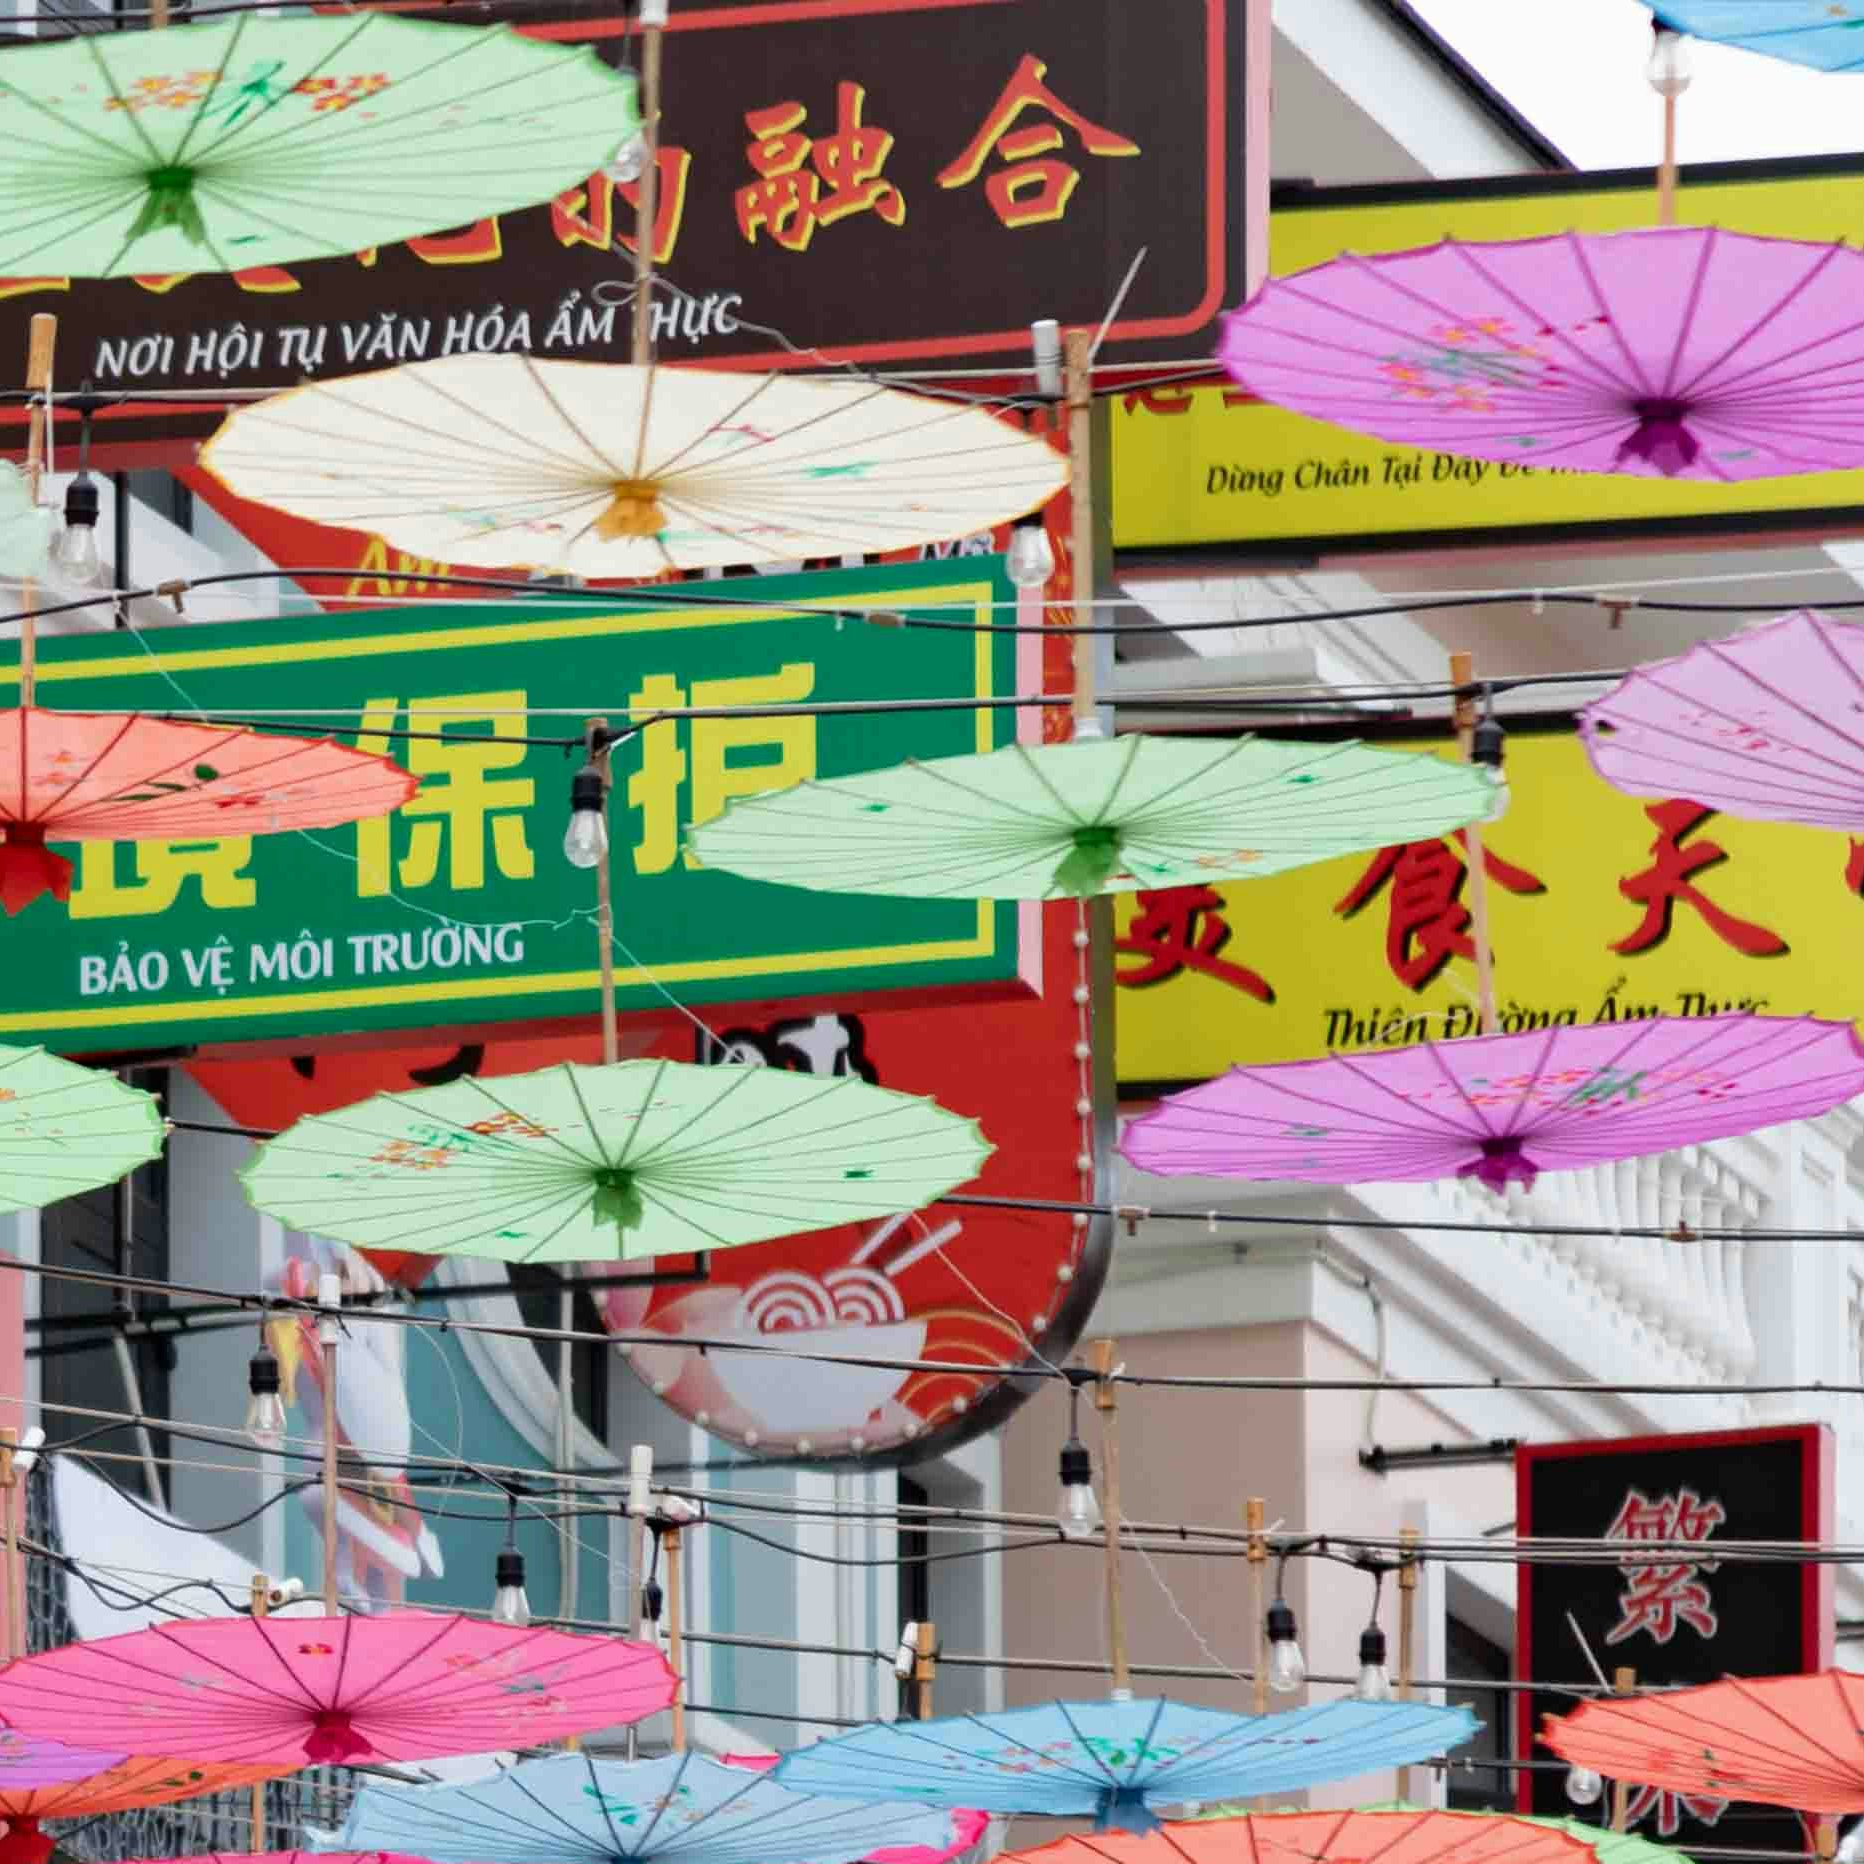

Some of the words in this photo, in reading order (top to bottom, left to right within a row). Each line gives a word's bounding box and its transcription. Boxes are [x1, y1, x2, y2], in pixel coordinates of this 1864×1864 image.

[95, 334, 175, 379] NƠI
[186, 322, 262, 384] HỘI
[278, 326, 327, 374] TỤ
[340, 312, 433, 364] VĂN
[441, 303, 533, 355] HÓA
[1294, 453, 1371, 491] Chân
[80, 941, 170, 996] BẢO
[181, 935, 236, 996] VỆ
[249, 929, 334, 984] MÔI
[347, 915, 525, 975] TRƯỜNG
